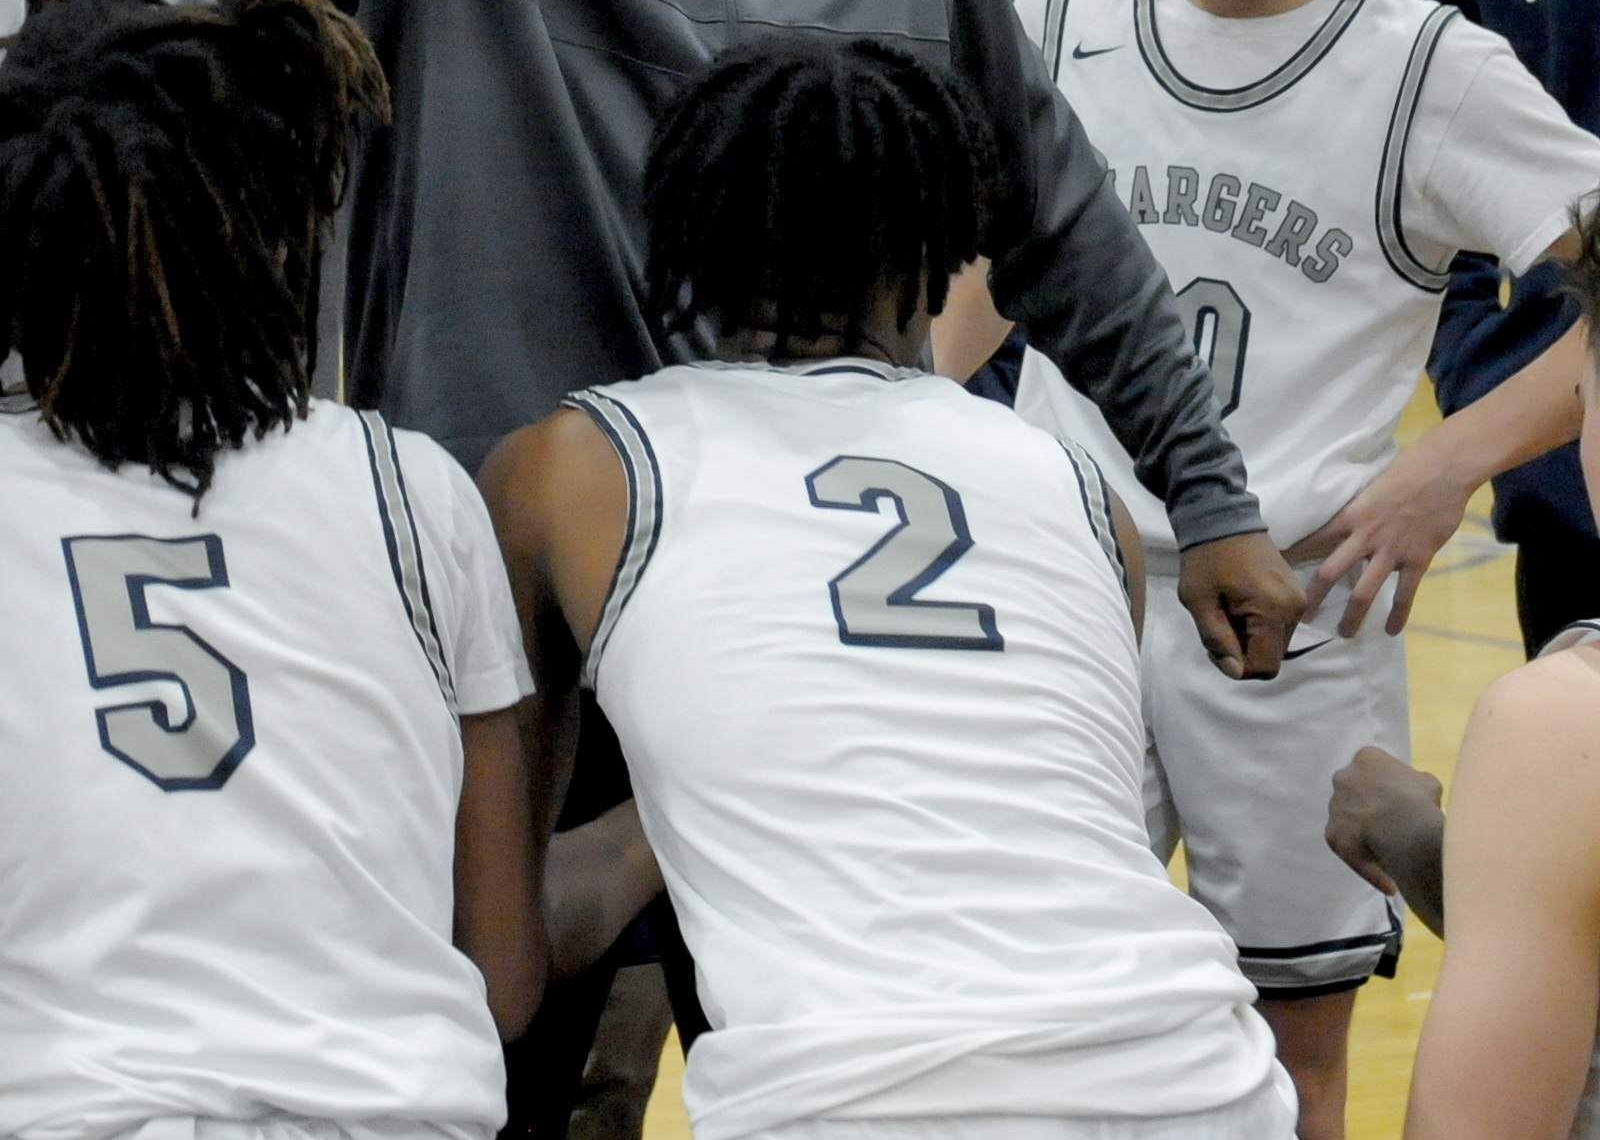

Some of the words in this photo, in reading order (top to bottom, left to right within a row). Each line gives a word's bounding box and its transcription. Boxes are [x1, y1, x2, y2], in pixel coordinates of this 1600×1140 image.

[1106, 165, 1354, 284] ARGERS
[805, 454, 1005, 651] 2
[60, 534, 256, 792] 5
